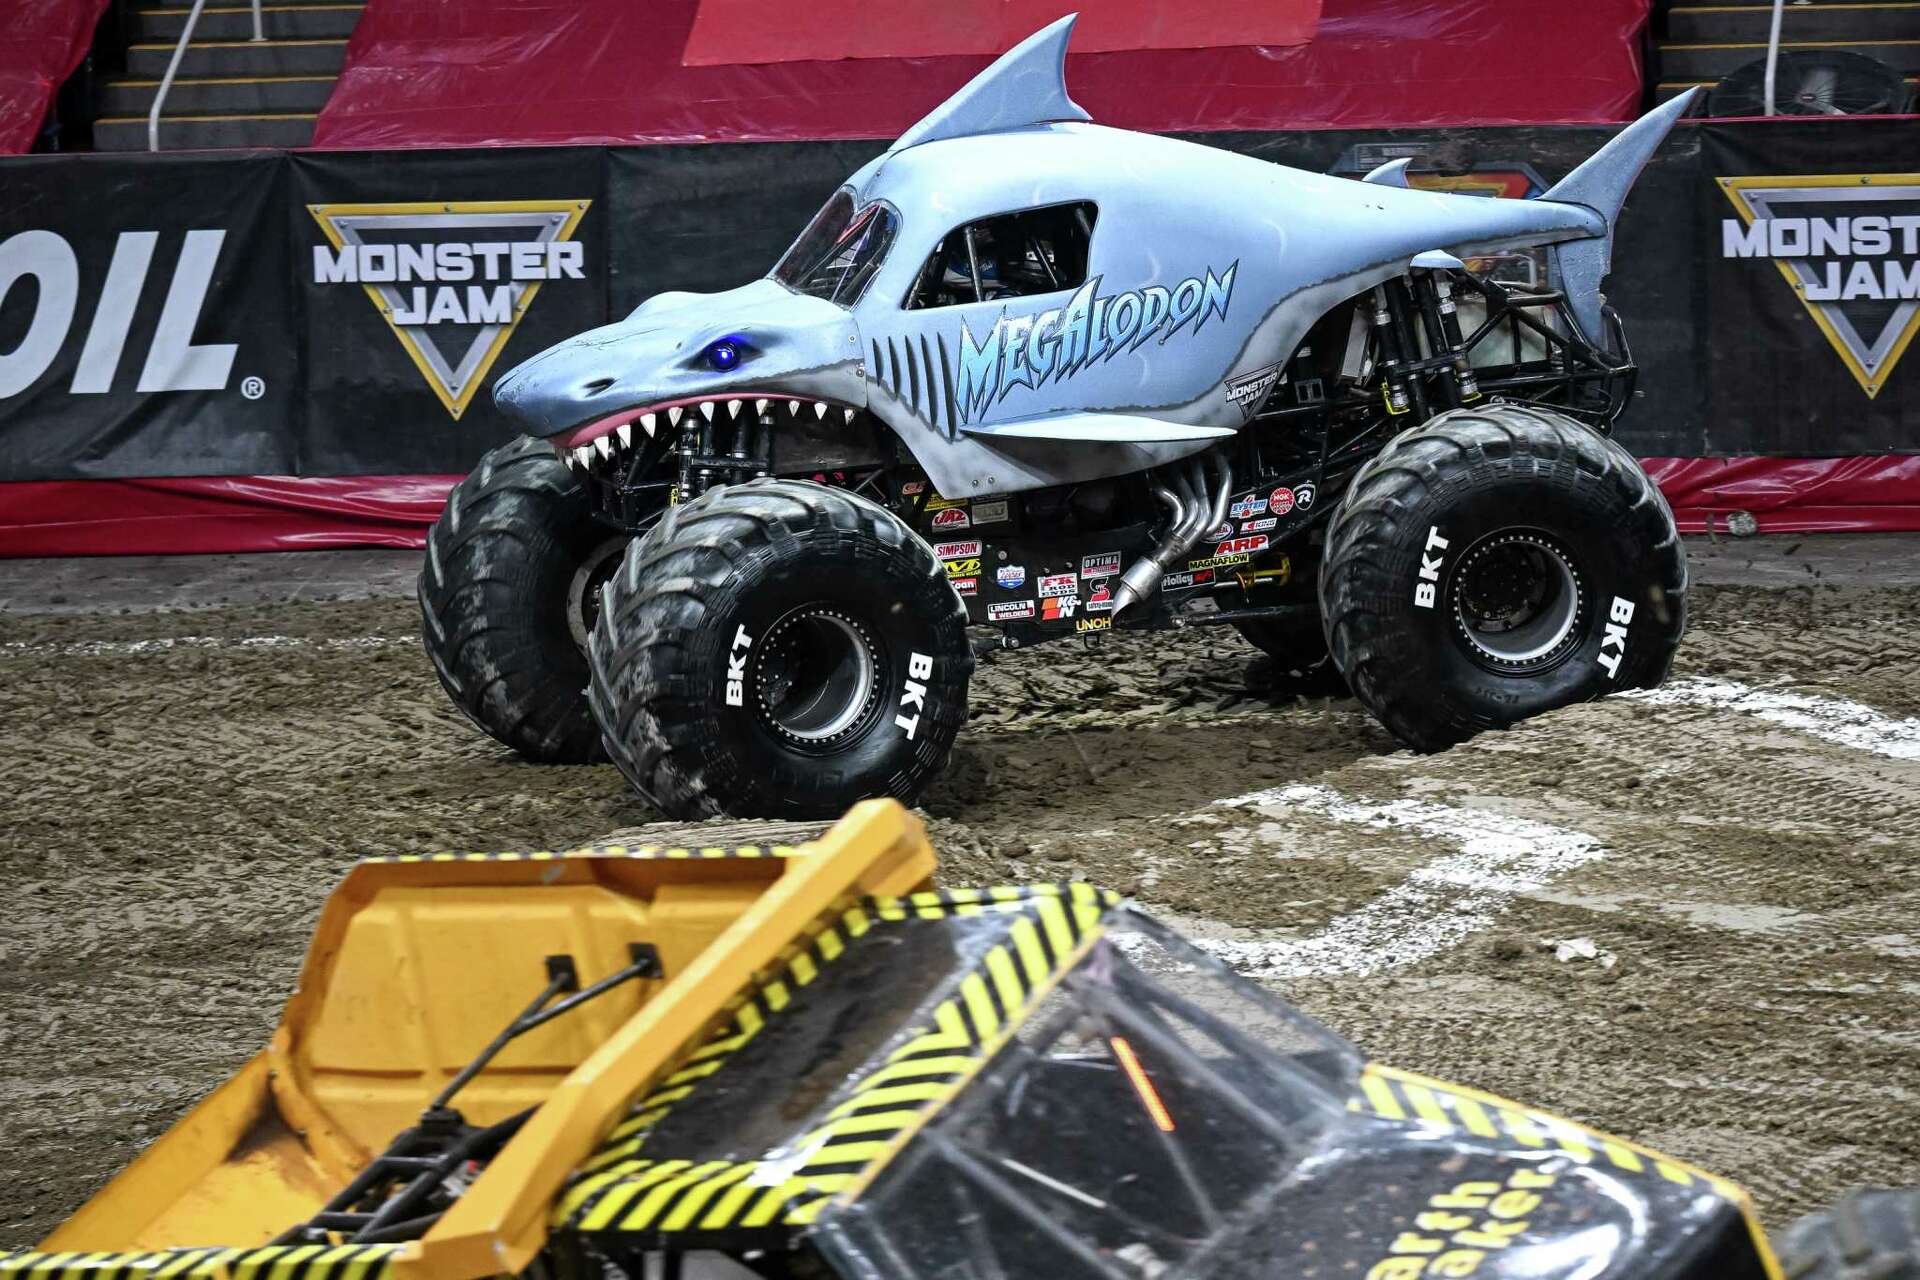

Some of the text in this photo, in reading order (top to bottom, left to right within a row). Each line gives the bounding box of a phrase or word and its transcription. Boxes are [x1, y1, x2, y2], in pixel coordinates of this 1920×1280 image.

[313, 241, 585, 283] MONSTER
[1804, 261, 1920, 300] JAM
[393, 286, 511, 325] JAM
[956, 258, 1240, 424] MEGALODON
[1226, 371, 1278, 402] MONSTER
[1241, 386, 1265, 406] JAM
[1273, 493, 1290, 501] NGK
[934, 509, 967, 524] JAZ
[1255, 518, 1276, 529] KING
[937, 543, 977, 557] SIMPSON
[1216, 536, 1267, 556] ARP
[1085, 556, 1117, 568] OPTIMA
[1189, 554, 1248, 570] MAGNAFLOW
[1415, 526, 1449, 608] BKT
[1163, 574, 1194, 586] Holley
[990, 602, 1027, 613] LINCOLN
[999, 610, 1030, 619] WELDERS
[1076, 617, 1111, 631] UNOH
[1597, 595, 1635, 679] BKT
[726, 623, 752, 707] BKT
[895, 652, 933, 741] BKT
